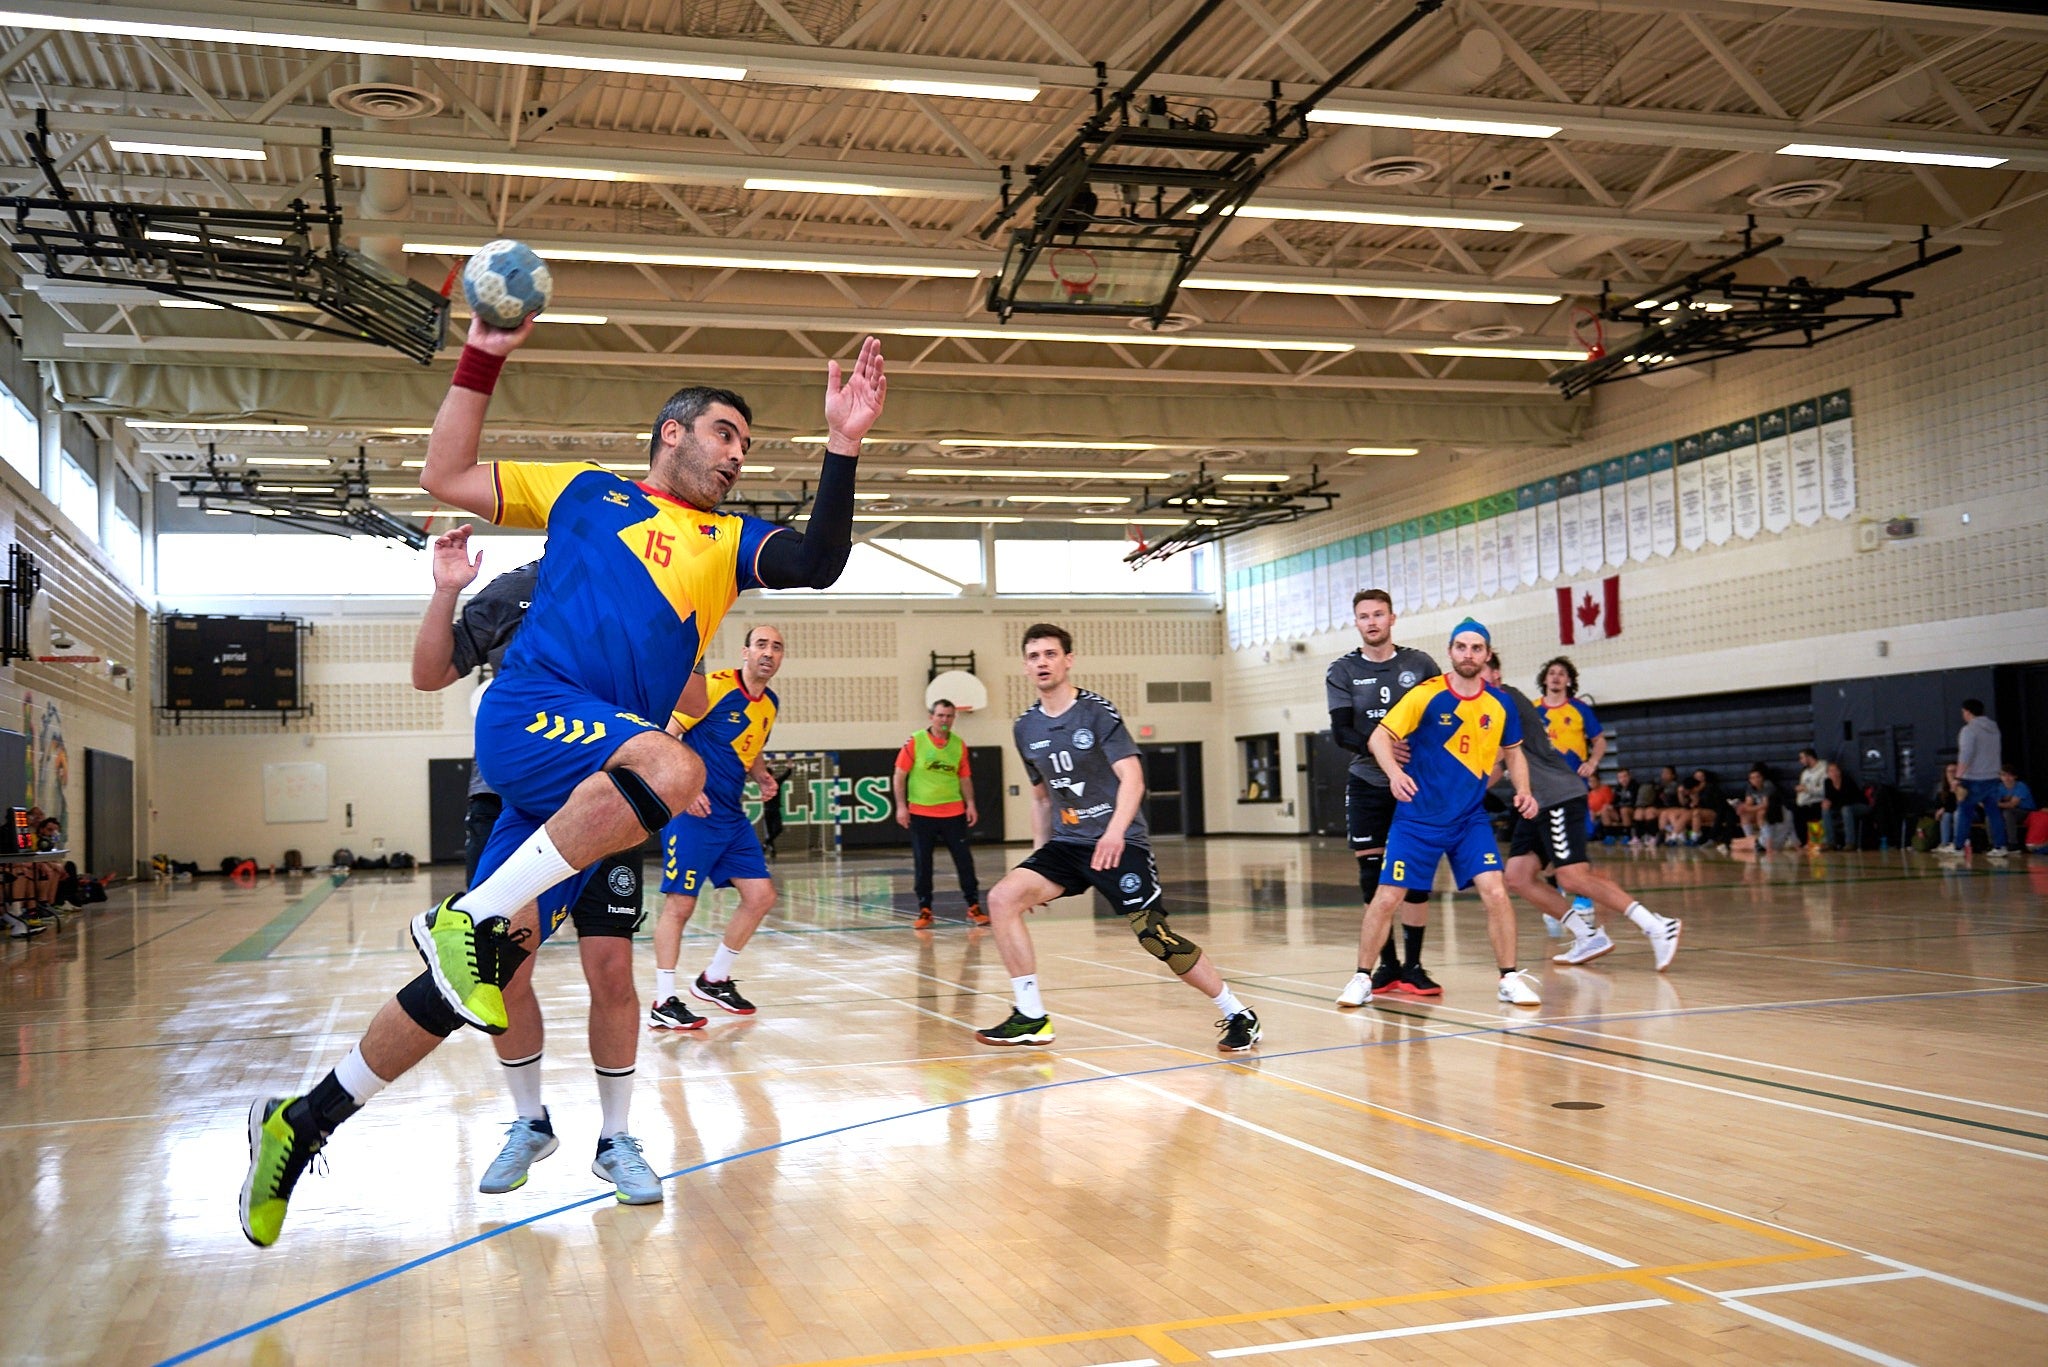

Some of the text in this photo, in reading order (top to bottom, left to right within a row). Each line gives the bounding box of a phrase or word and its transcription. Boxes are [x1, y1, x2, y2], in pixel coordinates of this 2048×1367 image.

[645, 530, 675, 568] 15
[1379, 686, 1391, 704] 9
[741, 734, 754, 752] 5
[1459, 734, 1471, 754] 6
[1047, 750, 1074, 774] 10
[684, 869, 697, 890] 5
[1393, 860, 1406, 881] 6
